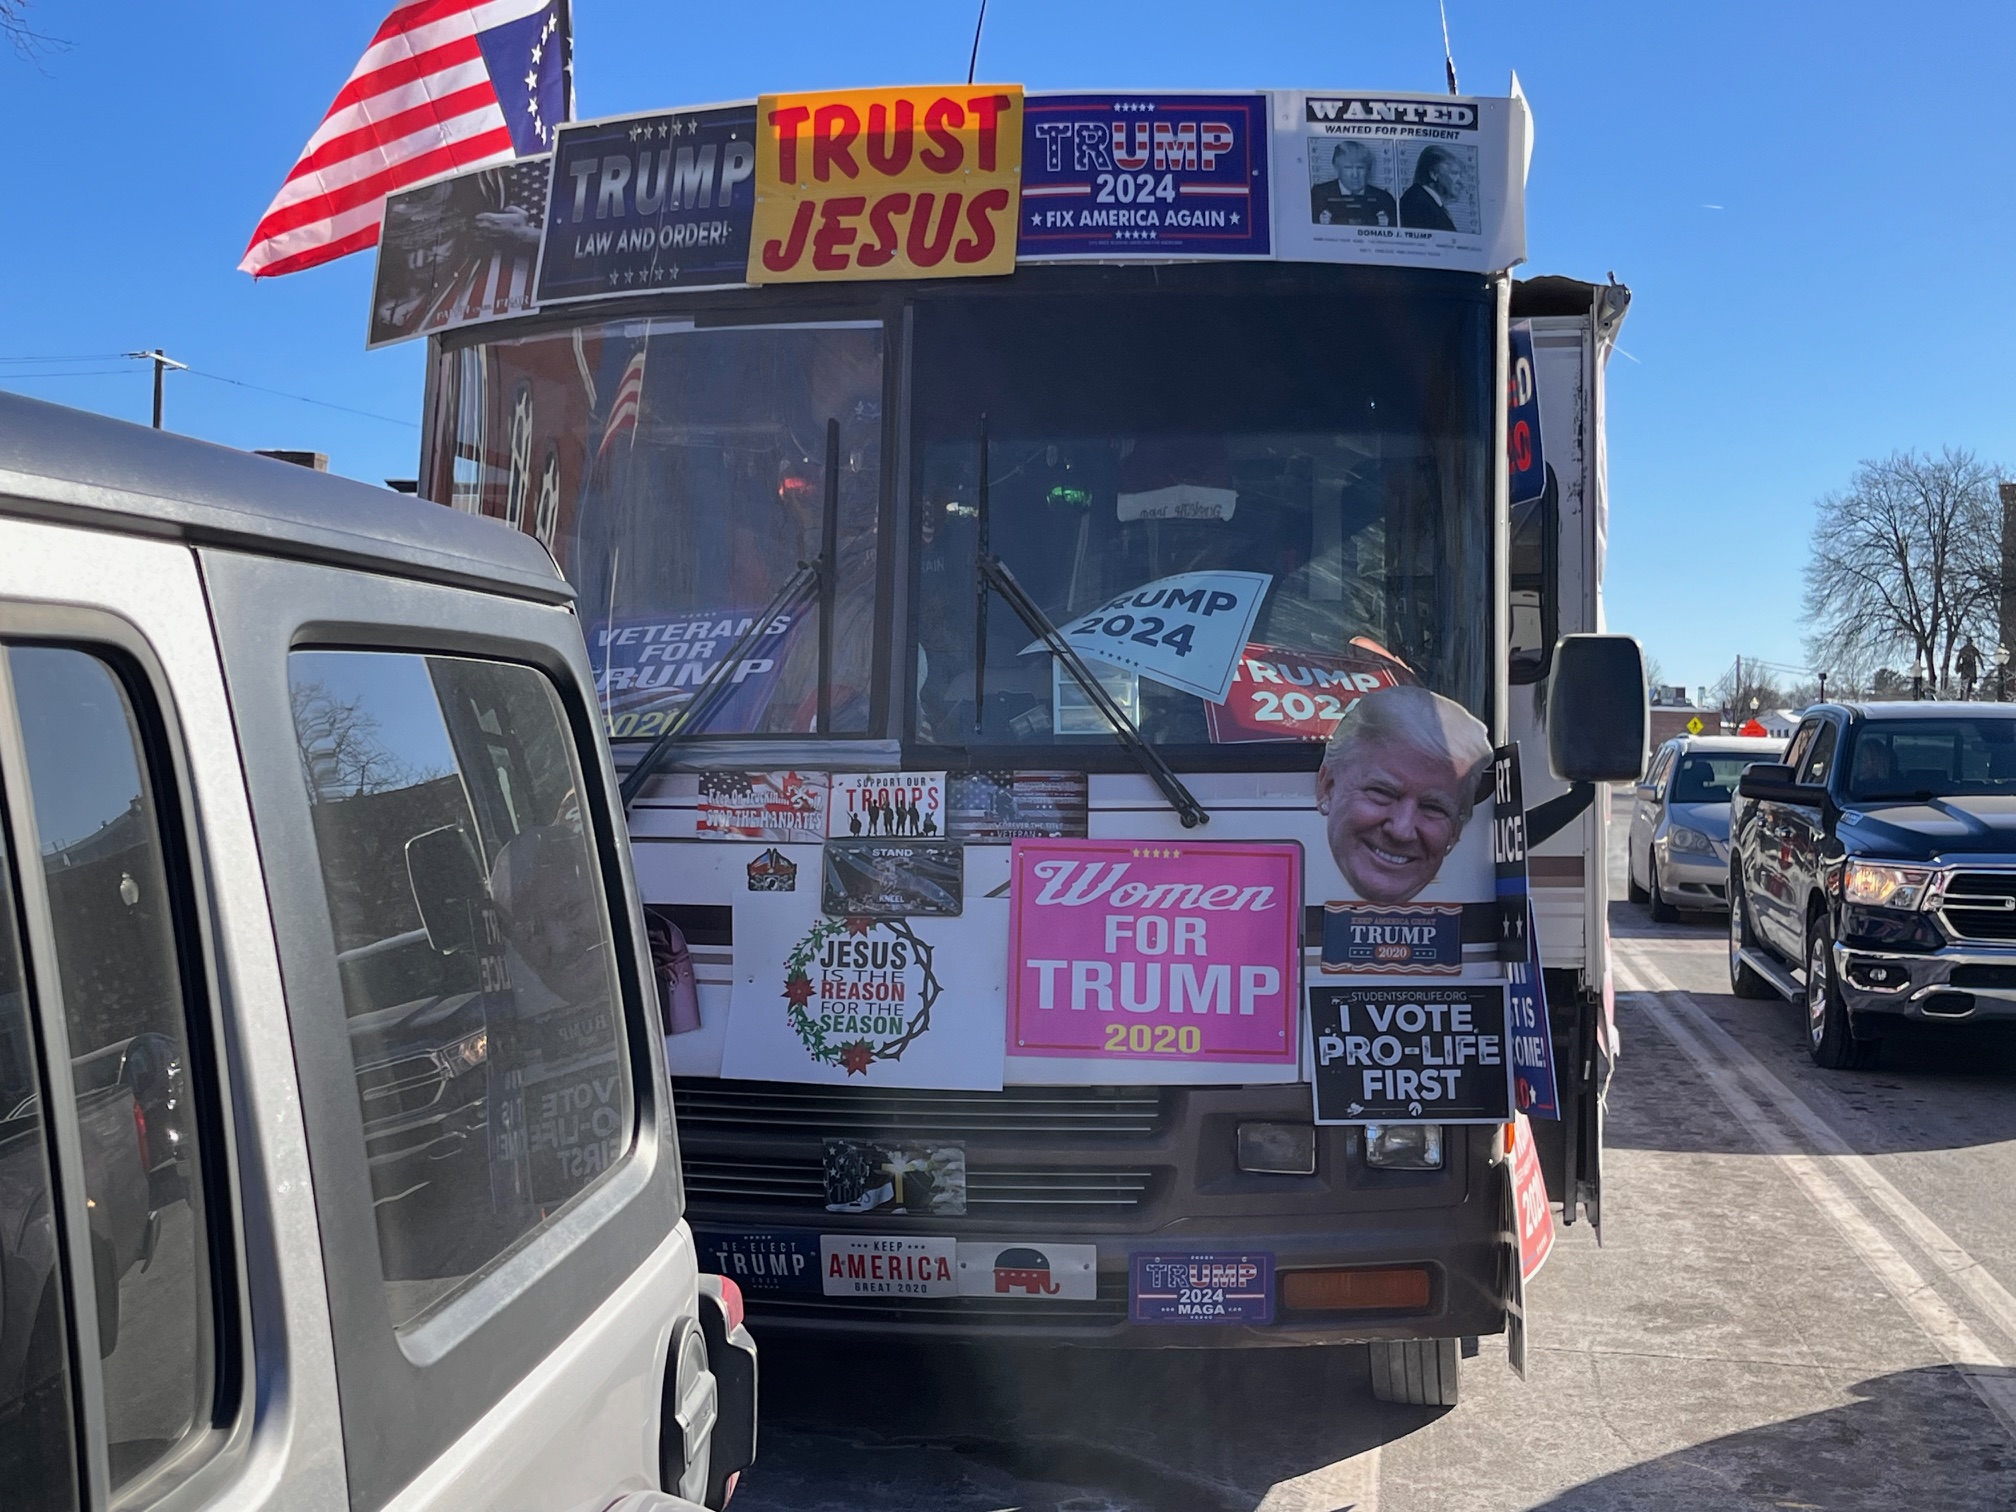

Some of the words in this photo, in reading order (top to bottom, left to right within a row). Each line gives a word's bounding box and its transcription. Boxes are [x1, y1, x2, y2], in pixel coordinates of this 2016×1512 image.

[1308, 100, 1475, 126] WANTED
[768, 95, 1011, 185] TRUST
[1325, 125, 1372, 135] WANTED
[1375, 126, 1398, 136] FOR
[1400, 127, 1461, 140] PRESIDENT
[1035, 121, 1234, 171] TRUMP
[569, 140, 755, 223] TRUMP
[1095, 174, 1176, 204] 2024
[761, 189, 1010, 272] JESUS
[1046, 210, 1075, 228] FIX
[1078, 209, 1160, 228] AMERICA
[1165, 209, 1225, 228] AGAIN
[574, 231, 613, 260] LAW
[615, 226, 656, 255] AND
[658, 220, 732, 250] ORDER!
[1357, 229, 1394, 238] DONALD
[1404, 231, 1433, 240] TRUMP
[1100, 588, 1238, 617] RUMP
[598, 616, 791, 647] VETERANS
[1071, 614, 1196, 658] 2024
[638, 640, 717, 663] FOR
[593, 659, 774, 692] RUMP
[857, 777, 902, 788] SUPPORT
[906, 777, 926, 787] OUR
[846, 787, 939, 812] TROOPS
[706, 809, 733, 828] STOP
[735, 810, 758, 828] THE
[760, 811, 822, 830] MANDATES
[996, 830, 1036, 838] VETERAN
[872, 848, 914, 857] STAND
[1033, 860, 1277, 912] Women
[879, 895, 905, 903] KNEEL
[1104, 914, 1208, 956] FOR
[1350, 925, 1437, 945] TRUMP
[820, 940, 907, 970] JESUS
[1378, 946, 1408, 958] 2020
[821, 969, 844, 983] IS
[855, 970, 904, 984] THE
[1026, 959, 1280, 1015] TRUMP
[820, 980, 906, 1002] REASON
[1351, 990, 1467, 1002] STUDENTSFORLIFE.ORG
[821, 1001, 859, 1015] FOR
[864, 1002, 904, 1017] THE
[1340, 1004, 1351, 1032] I
[1365, 1004, 1474, 1033] VOTE
[819, 1014, 903, 1035] SEASON
[1104, 1024, 1201, 1053] 2020
[1318, 1034, 1501, 1066] PRO-LIFE
[1362, 1068, 1462, 1101] FIRST
[722, 1241, 797, 1253] RE-ELECT
[873, 1241, 904, 1251] KEEP
[716, 1251, 805, 1277] TRUMP
[829, 1252, 952, 1282] AMERICA
[1146, 1263, 1258, 1288] TRUMP
[854, 1282, 892, 1293] GREAT
[898, 1283, 928, 1294] 2020
[1179, 1288, 1224, 1303] 2024
[1178, 1304, 1225, 1315] MAGA
